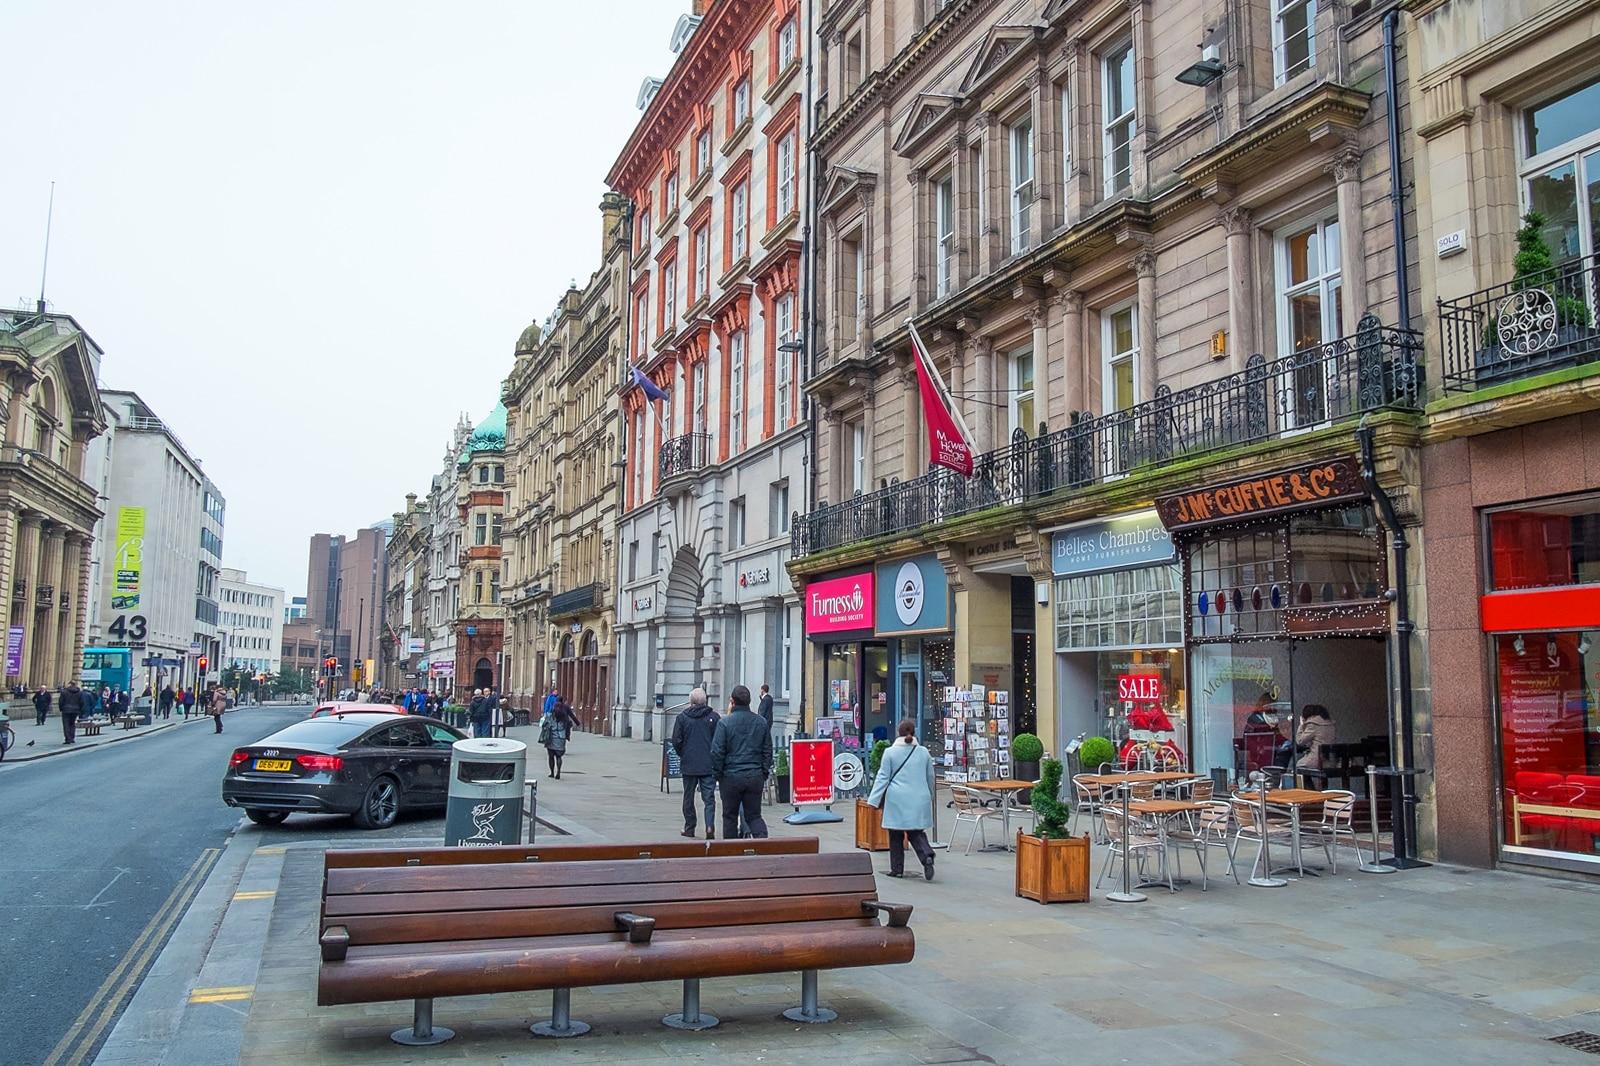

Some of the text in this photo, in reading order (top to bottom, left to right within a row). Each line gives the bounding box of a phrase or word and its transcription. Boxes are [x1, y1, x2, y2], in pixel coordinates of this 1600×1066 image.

[1439, 234, 1459, 247] SOLO
[1057, 525, 1169, 558] Belles Chambres
[1071, 544, 1152, 563] HOME FURNISHINGS
[812, 593, 851, 617] Furness
[108, 614, 147, 640] 43
[829, 613, 864, 623] BUILDING SOCIETY
[1119, 678, 1160, 698] SALE
[457, 839, 503, 848] Liverpool
